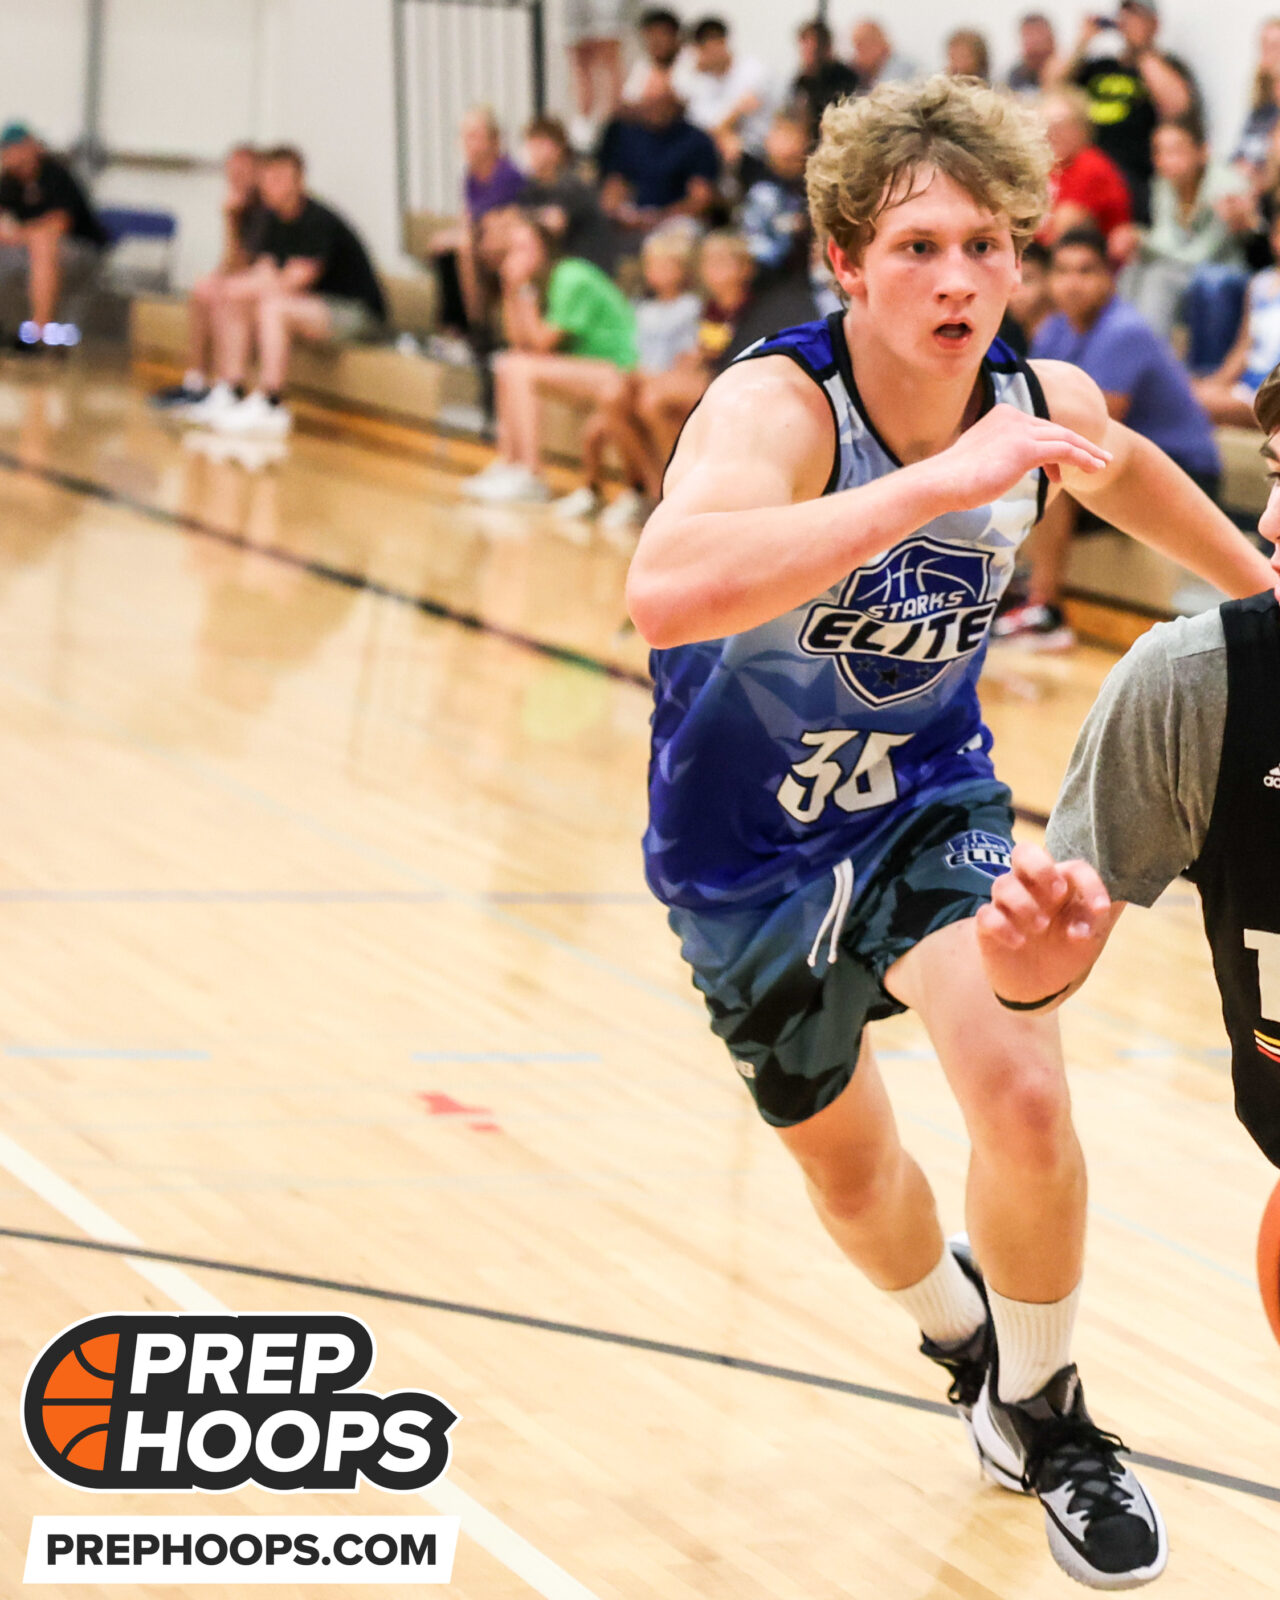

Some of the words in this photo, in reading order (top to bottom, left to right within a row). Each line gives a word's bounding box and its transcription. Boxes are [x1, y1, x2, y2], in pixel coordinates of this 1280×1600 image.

[867, 590, 967, 620] STARKS
[808, 607, 993, 660] ELITE
[950, 850, 1011, 865] ELIT
